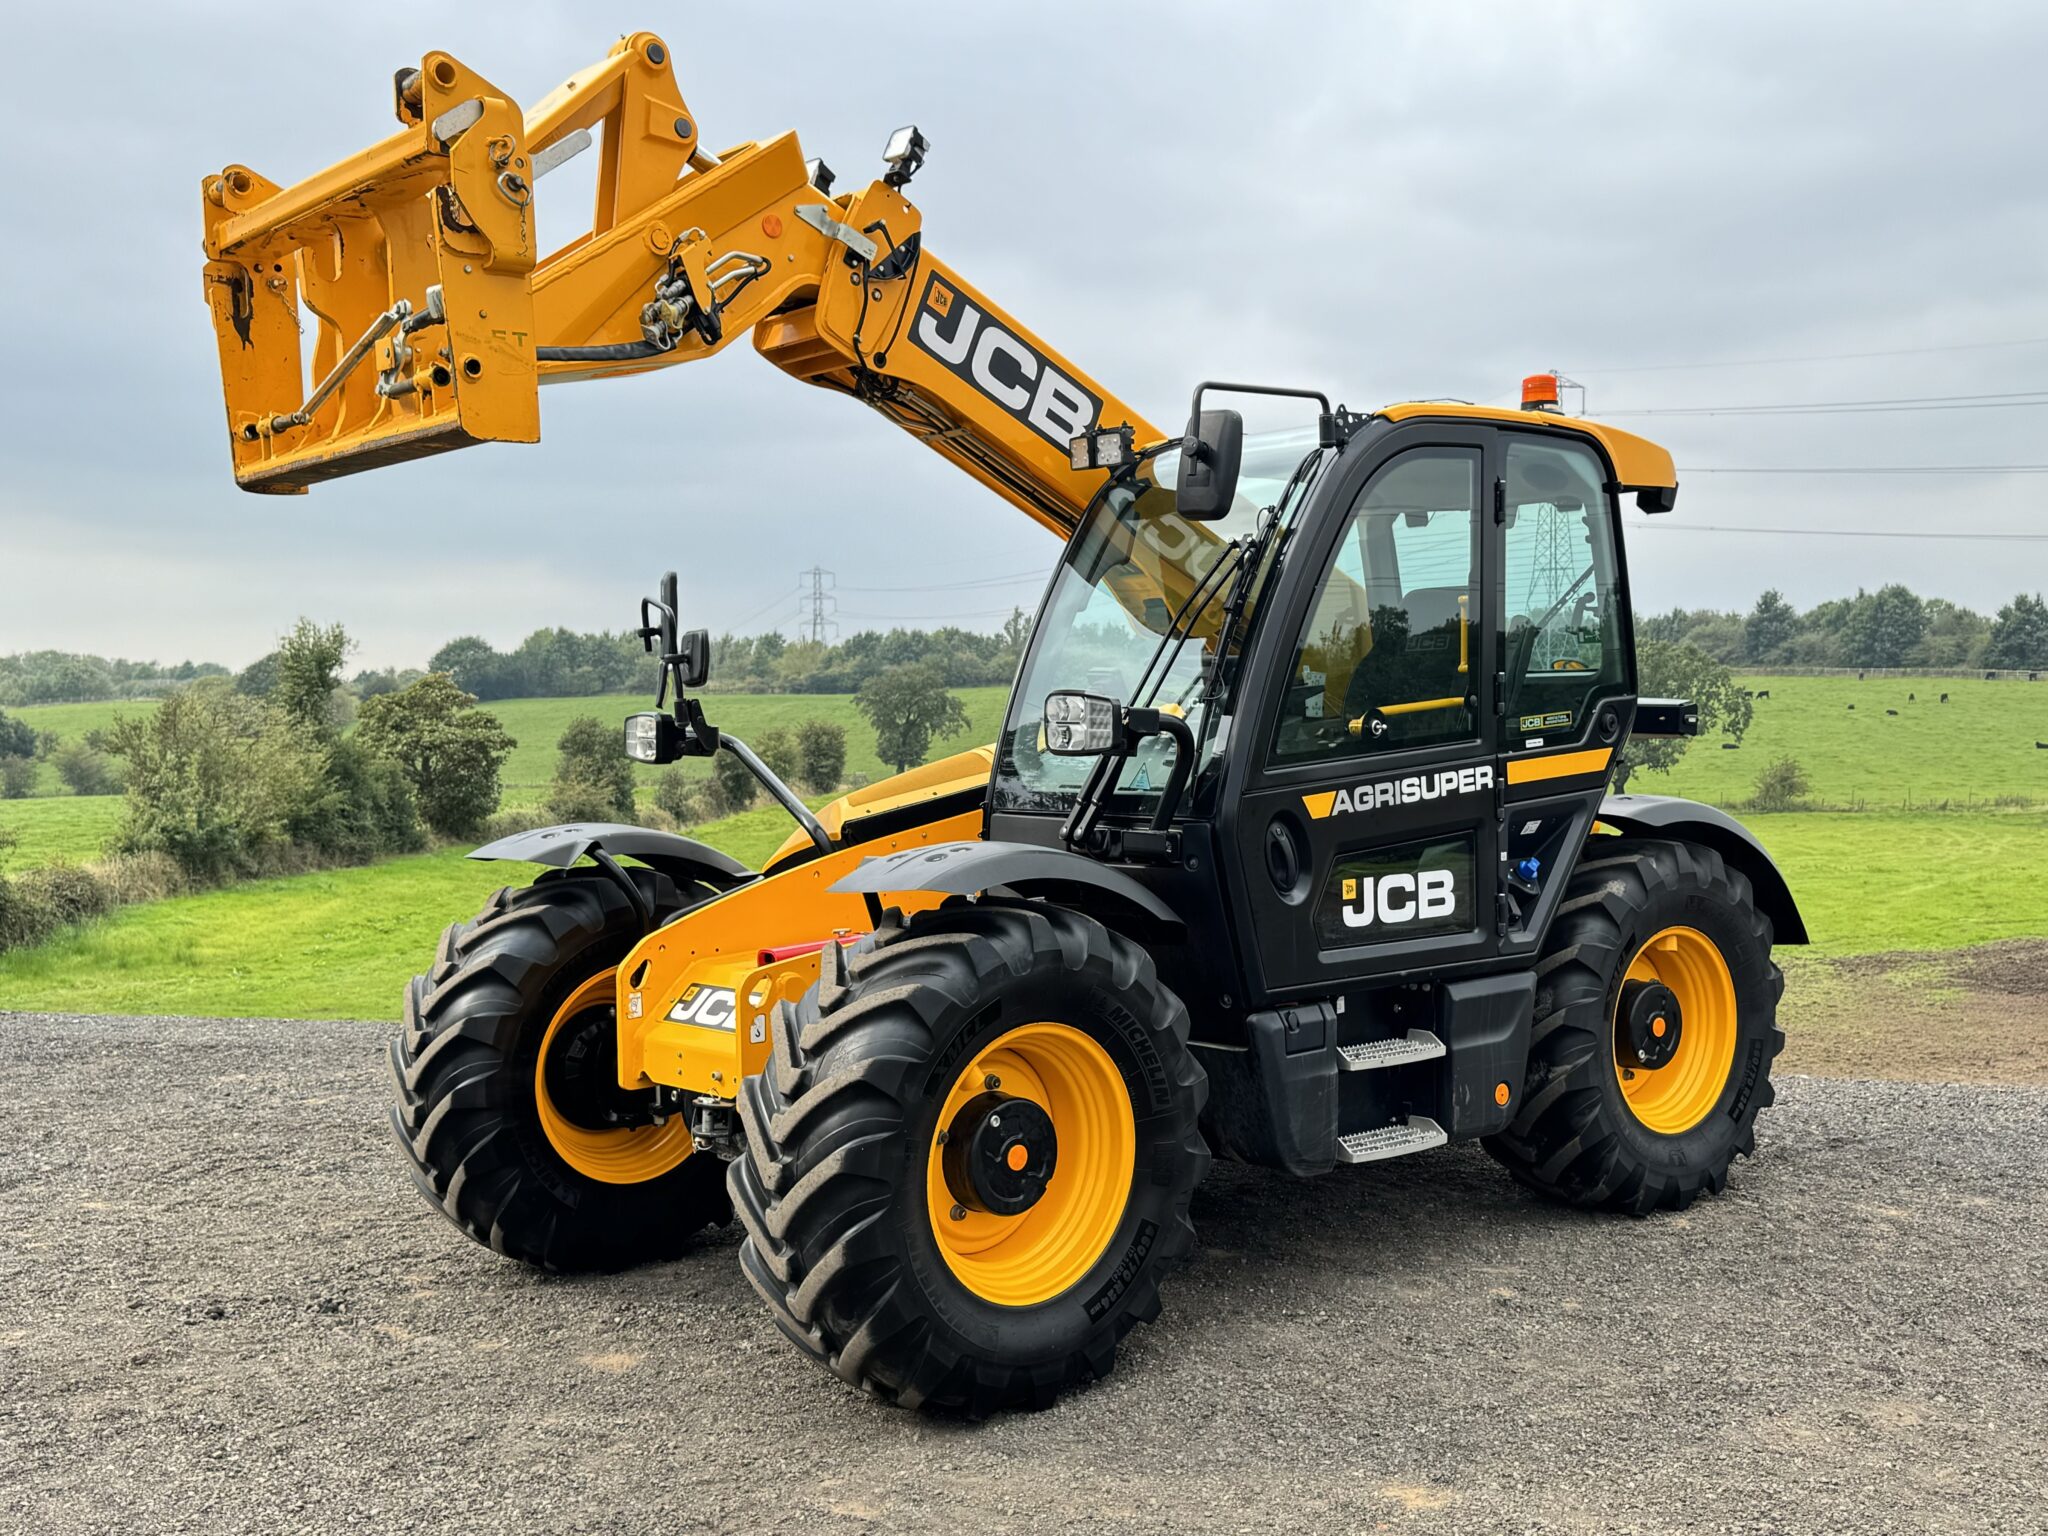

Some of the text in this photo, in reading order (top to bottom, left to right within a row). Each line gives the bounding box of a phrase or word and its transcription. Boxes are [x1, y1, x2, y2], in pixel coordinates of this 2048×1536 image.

[918, 304, 1094, 450] JCB
[1406, 635, 1449, 650] JCB
[1522, 718, 1541, 728] JCB
[1331, 765, 1494, 817] AGRISUPER
[1342, 869, 1456, 928] JCB
[670, 988, 736, 1029] JC
[1106, 1005, 1171, 1106] MICHELIN
